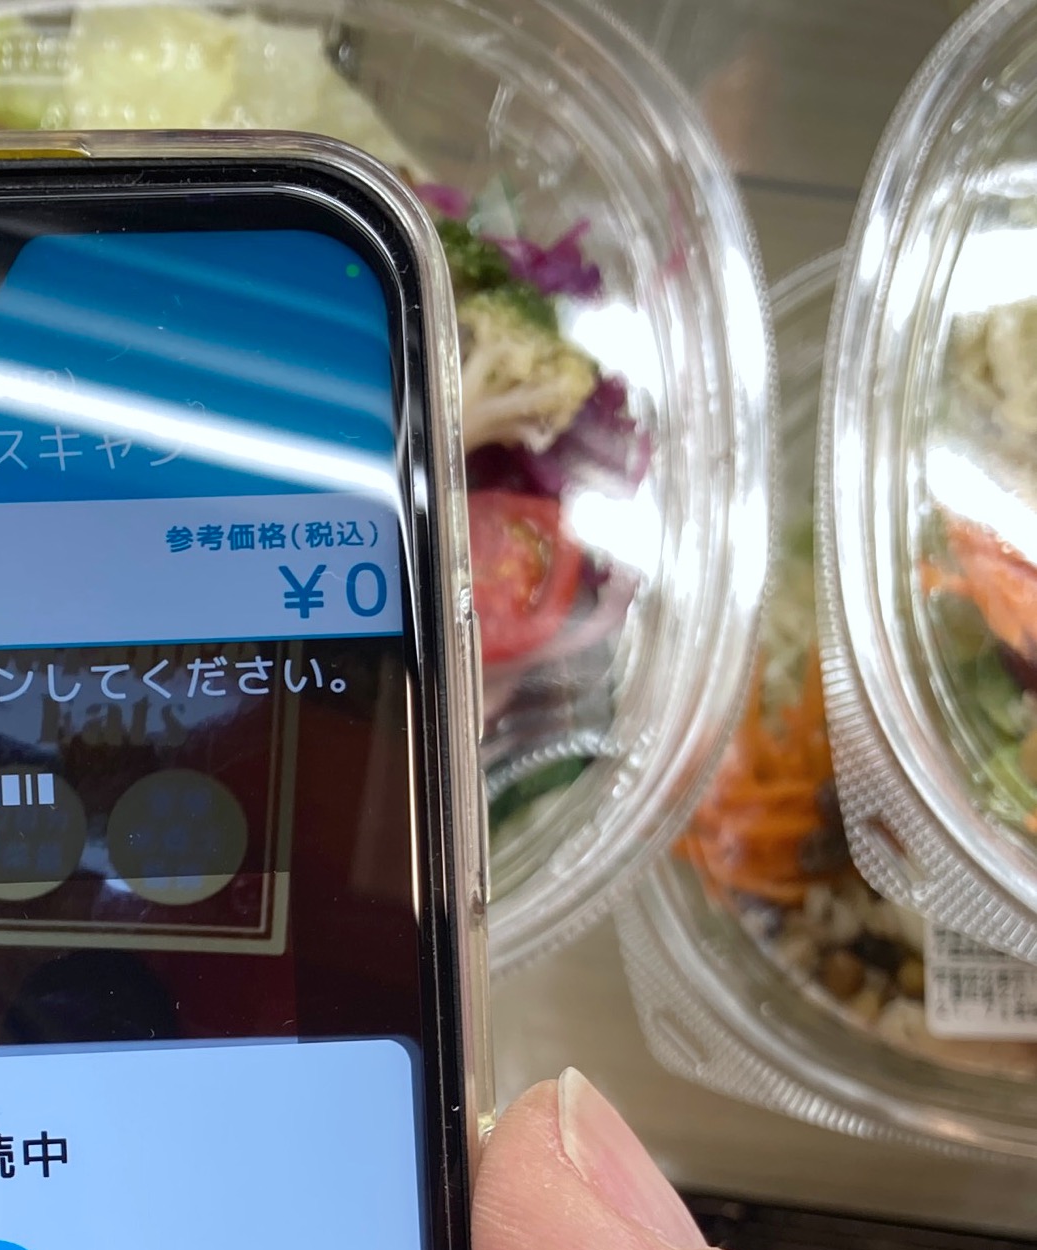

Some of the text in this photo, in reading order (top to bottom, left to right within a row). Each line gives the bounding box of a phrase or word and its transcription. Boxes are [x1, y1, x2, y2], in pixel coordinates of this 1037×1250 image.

[165, 519, 382, 554] 参考価格(税込)
